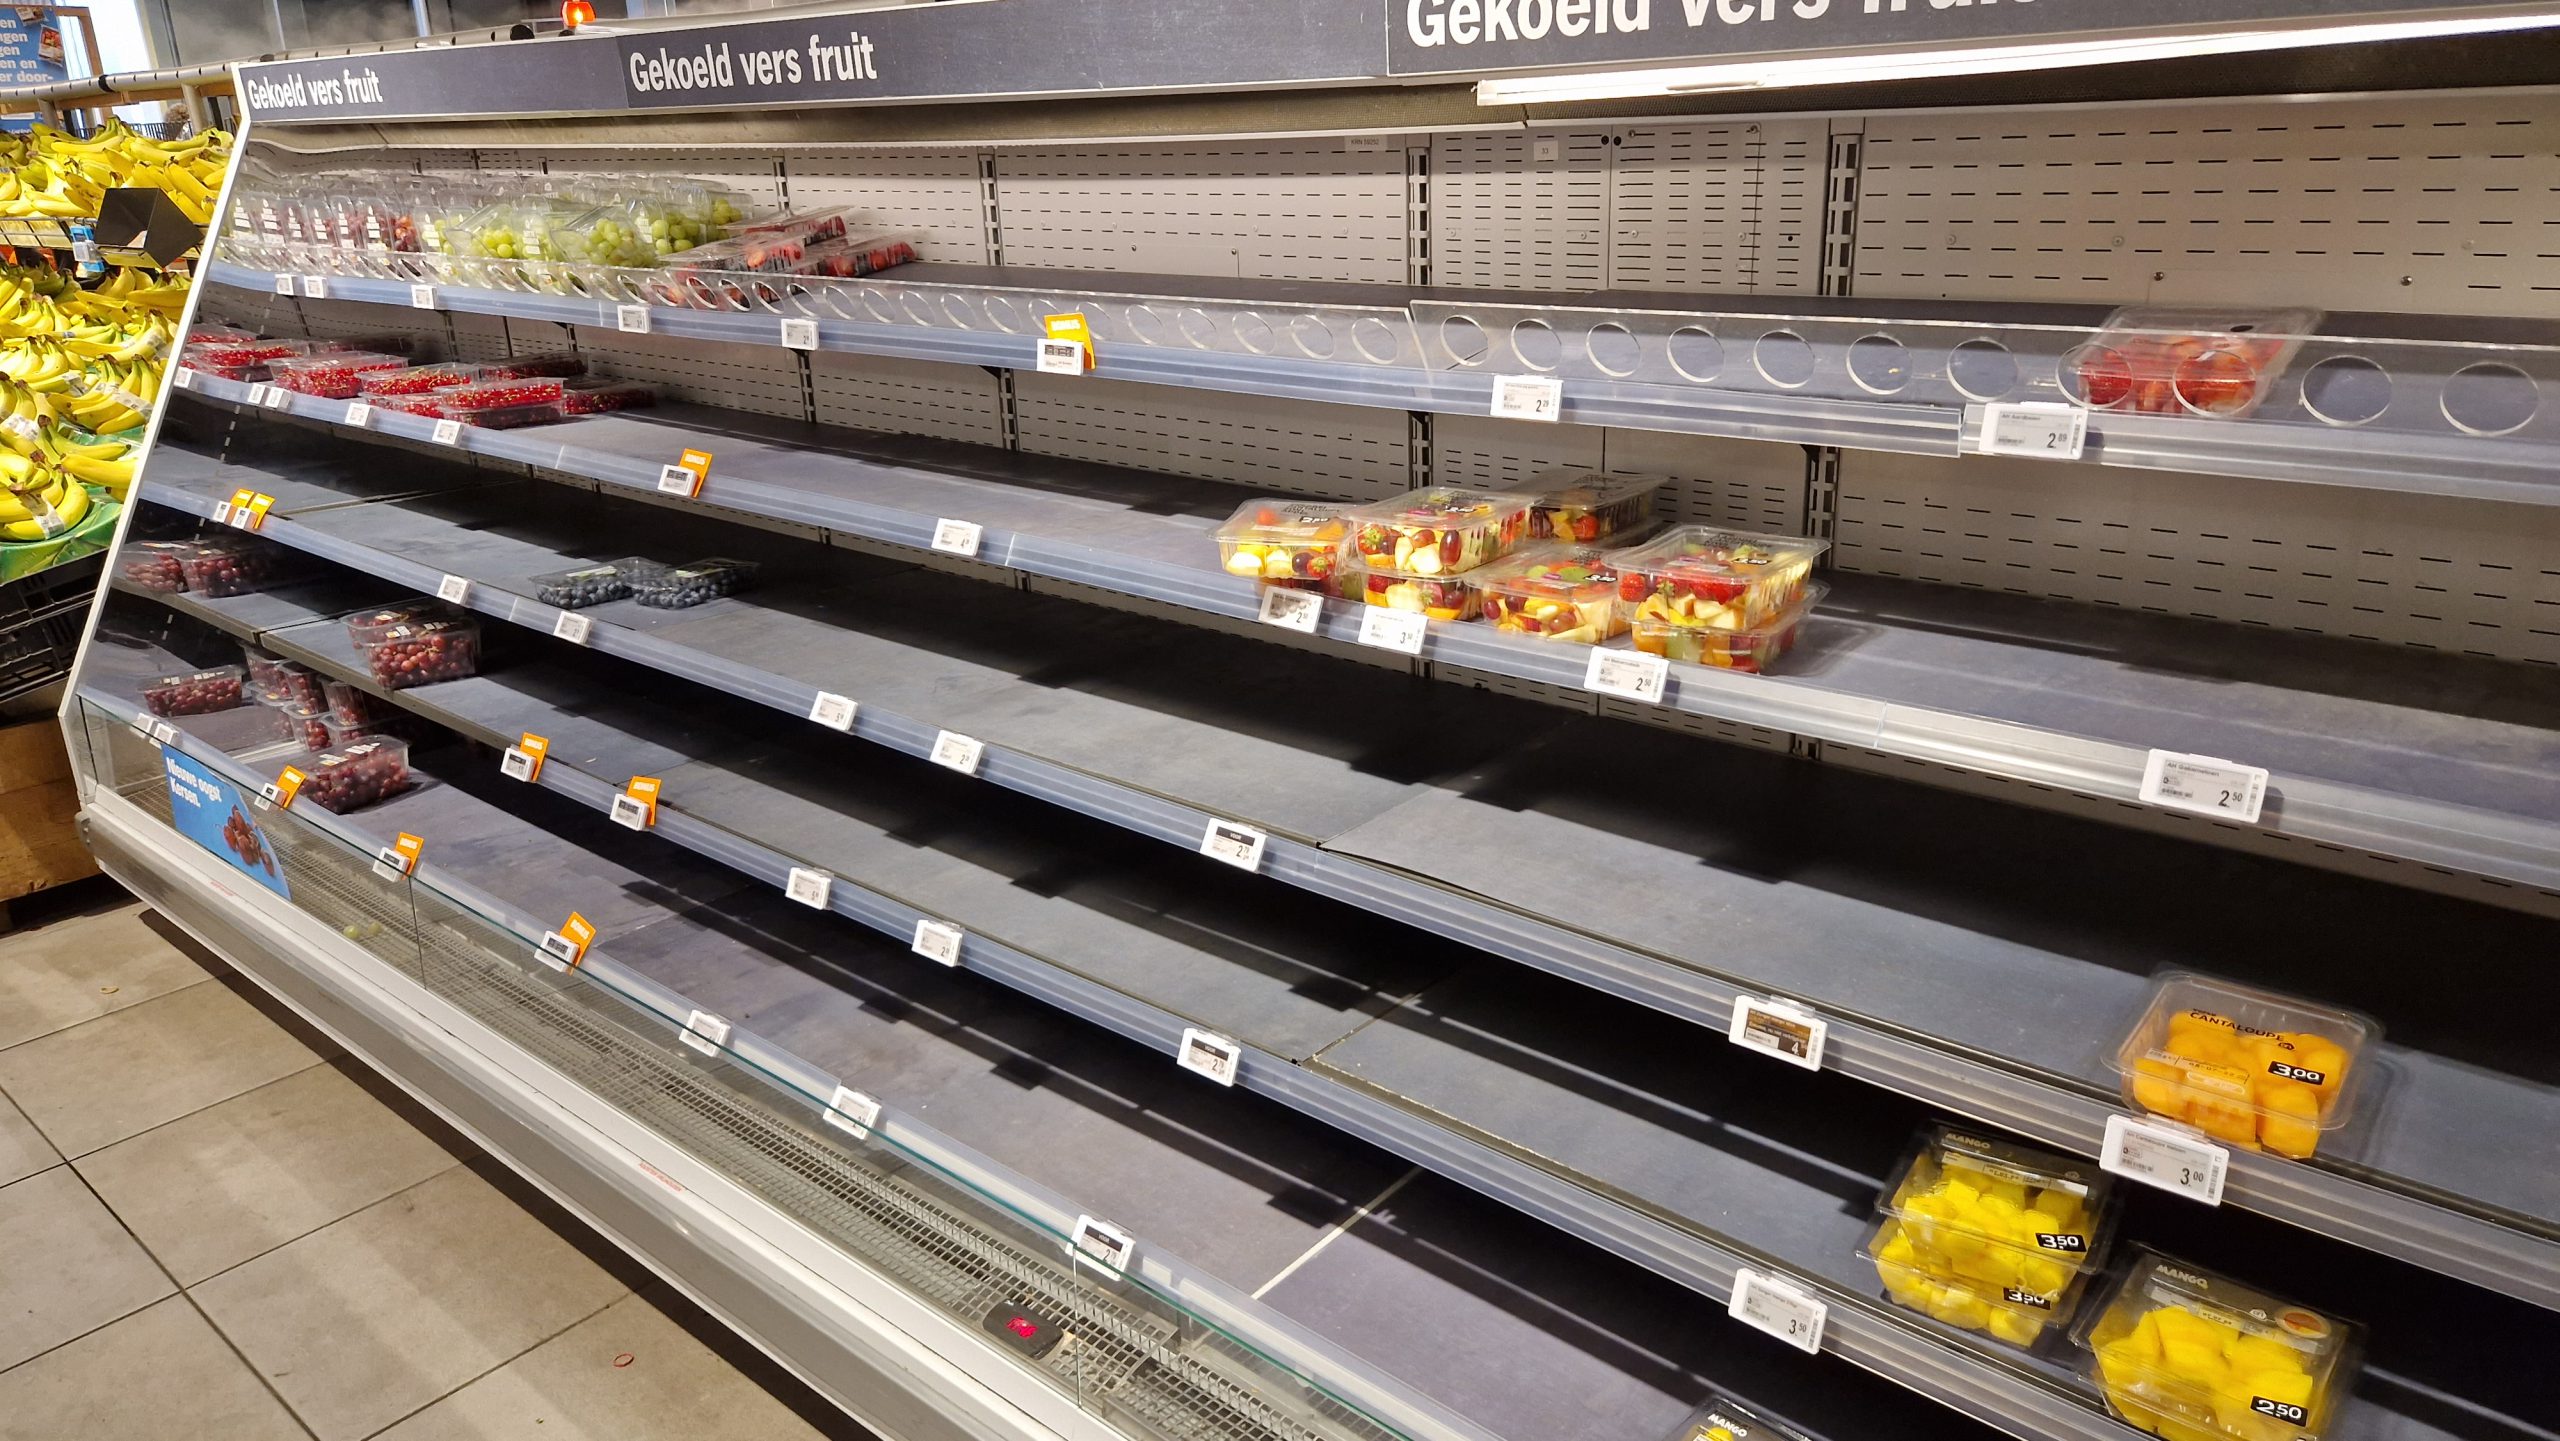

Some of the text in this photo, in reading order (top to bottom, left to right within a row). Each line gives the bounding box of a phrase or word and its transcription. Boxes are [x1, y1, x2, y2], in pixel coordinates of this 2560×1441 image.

[1406, 0, 1650, 47] Gekoeld
[20, 60, 37, 69] en
[630, 32, 878, 92] Gekoeld vers fruit
[17, 70, 54, 82] door-
[248, 68, 384, 110] Gekoeld vers fruit
[166, 756, 222, 803] Nieuwe oogst
[2189, 1012, 2286, 1042] CANTALOUPE
[1946, 1133, 1991, 1149] MANGO
[2040, 1234, 2080, 1250] 3.50
[2156, 1264, 2209, 1289] MANGO
[2256, 1399, 2302, 1419] 2.50
[1707, 1413, 1748, 1437] MANGO
